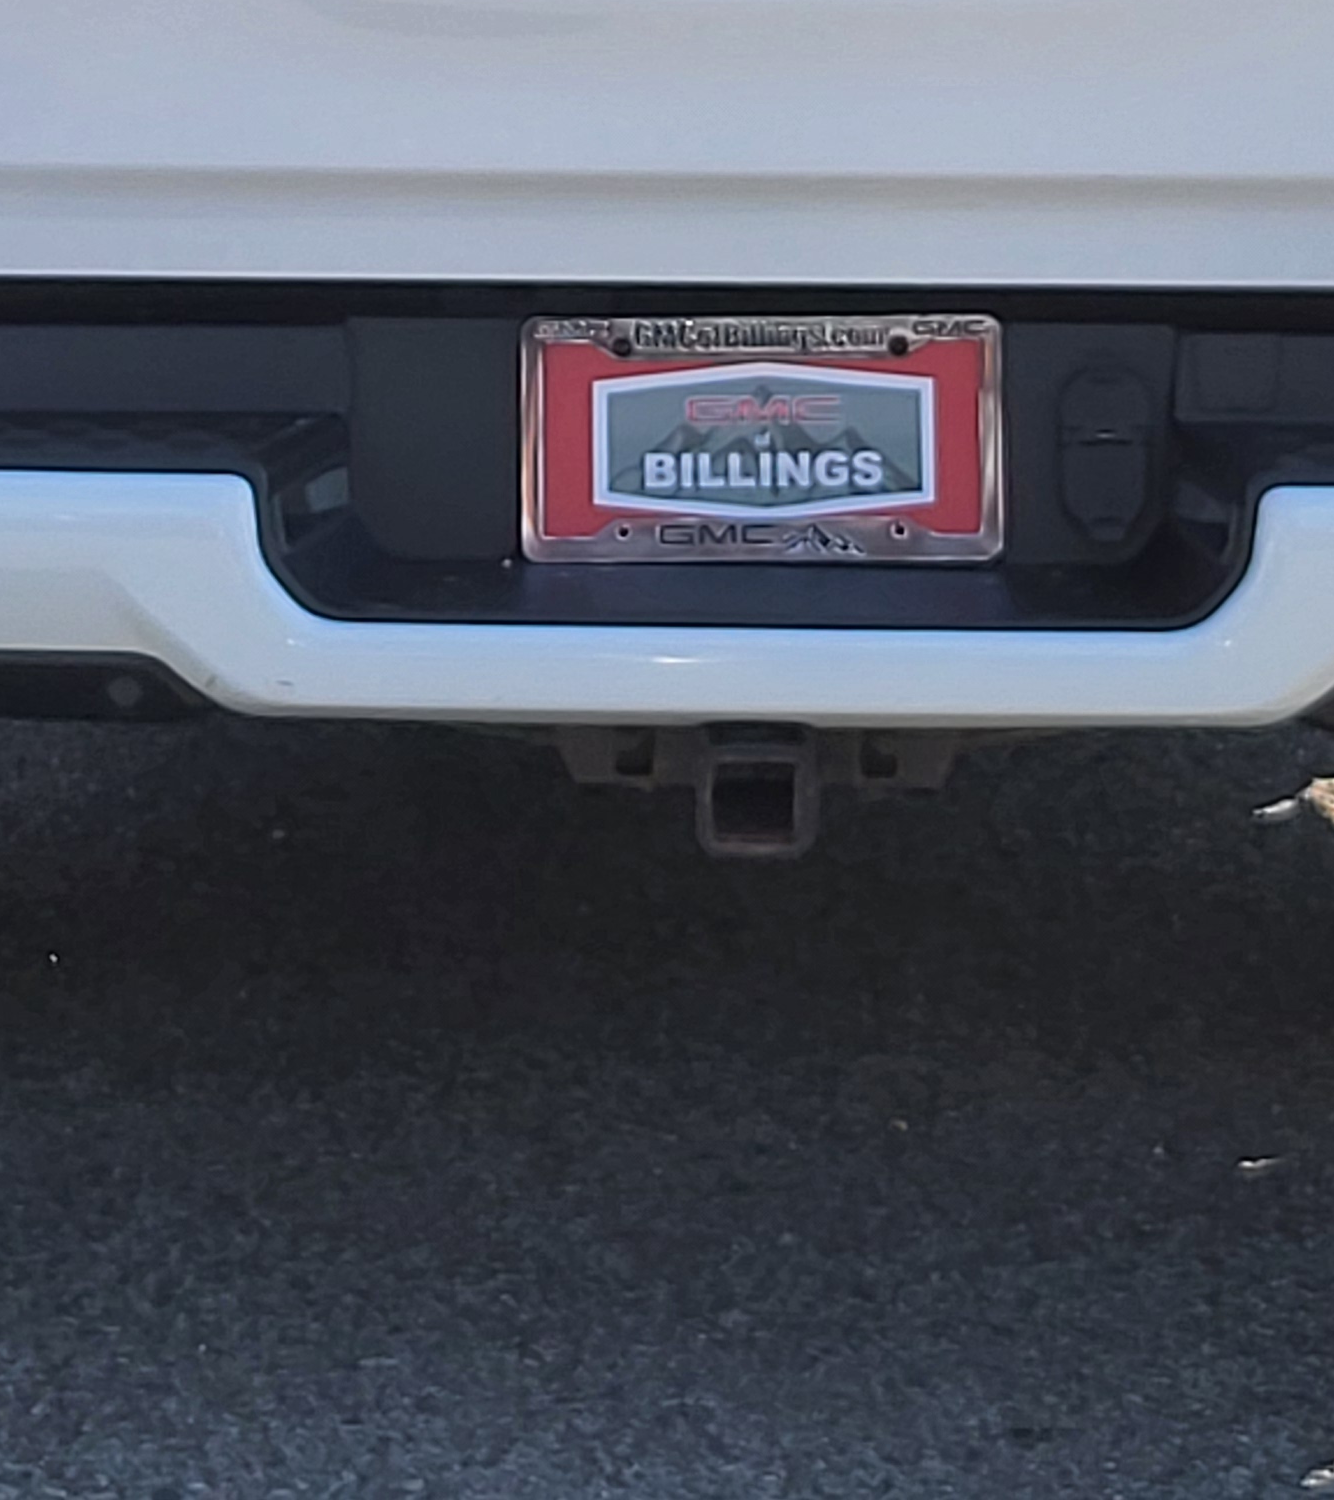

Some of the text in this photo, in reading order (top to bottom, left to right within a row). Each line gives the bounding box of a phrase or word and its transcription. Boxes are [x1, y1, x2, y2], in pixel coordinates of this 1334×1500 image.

[913, 318, 990, 336] GMC
[685, 394, 841, 424] GMC
[642, 449, 883, 489] BILLINGS
[658, 522, 779, 547] GMC
